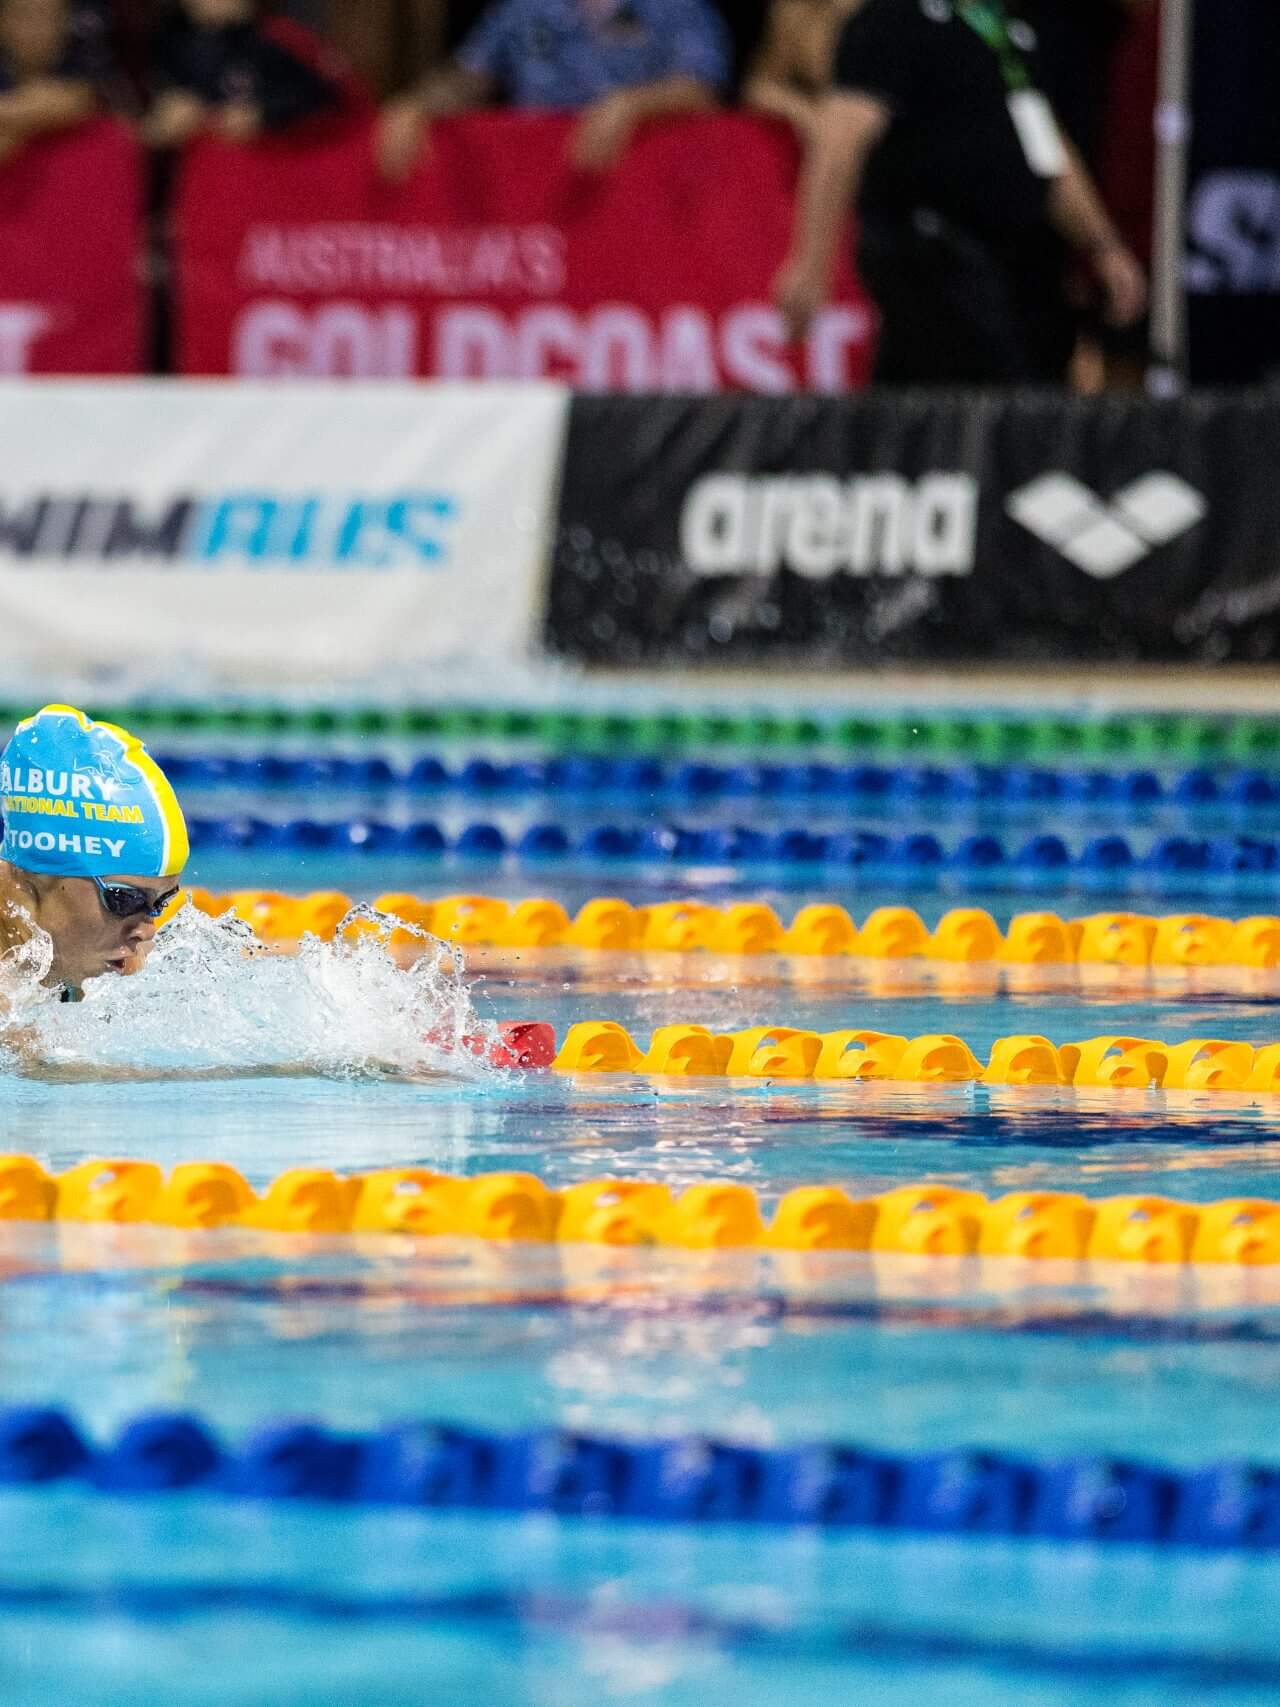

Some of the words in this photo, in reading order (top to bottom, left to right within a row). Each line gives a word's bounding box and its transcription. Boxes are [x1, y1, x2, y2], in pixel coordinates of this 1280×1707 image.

[683, 471, 977, 575] arena
[1, 765, 115, 801] ALBURY
[3, 795, 80, 818] ATIONAL
[81, 801, 145, 824] TEAM
[10, 828, 127, 858] TOOHEY
